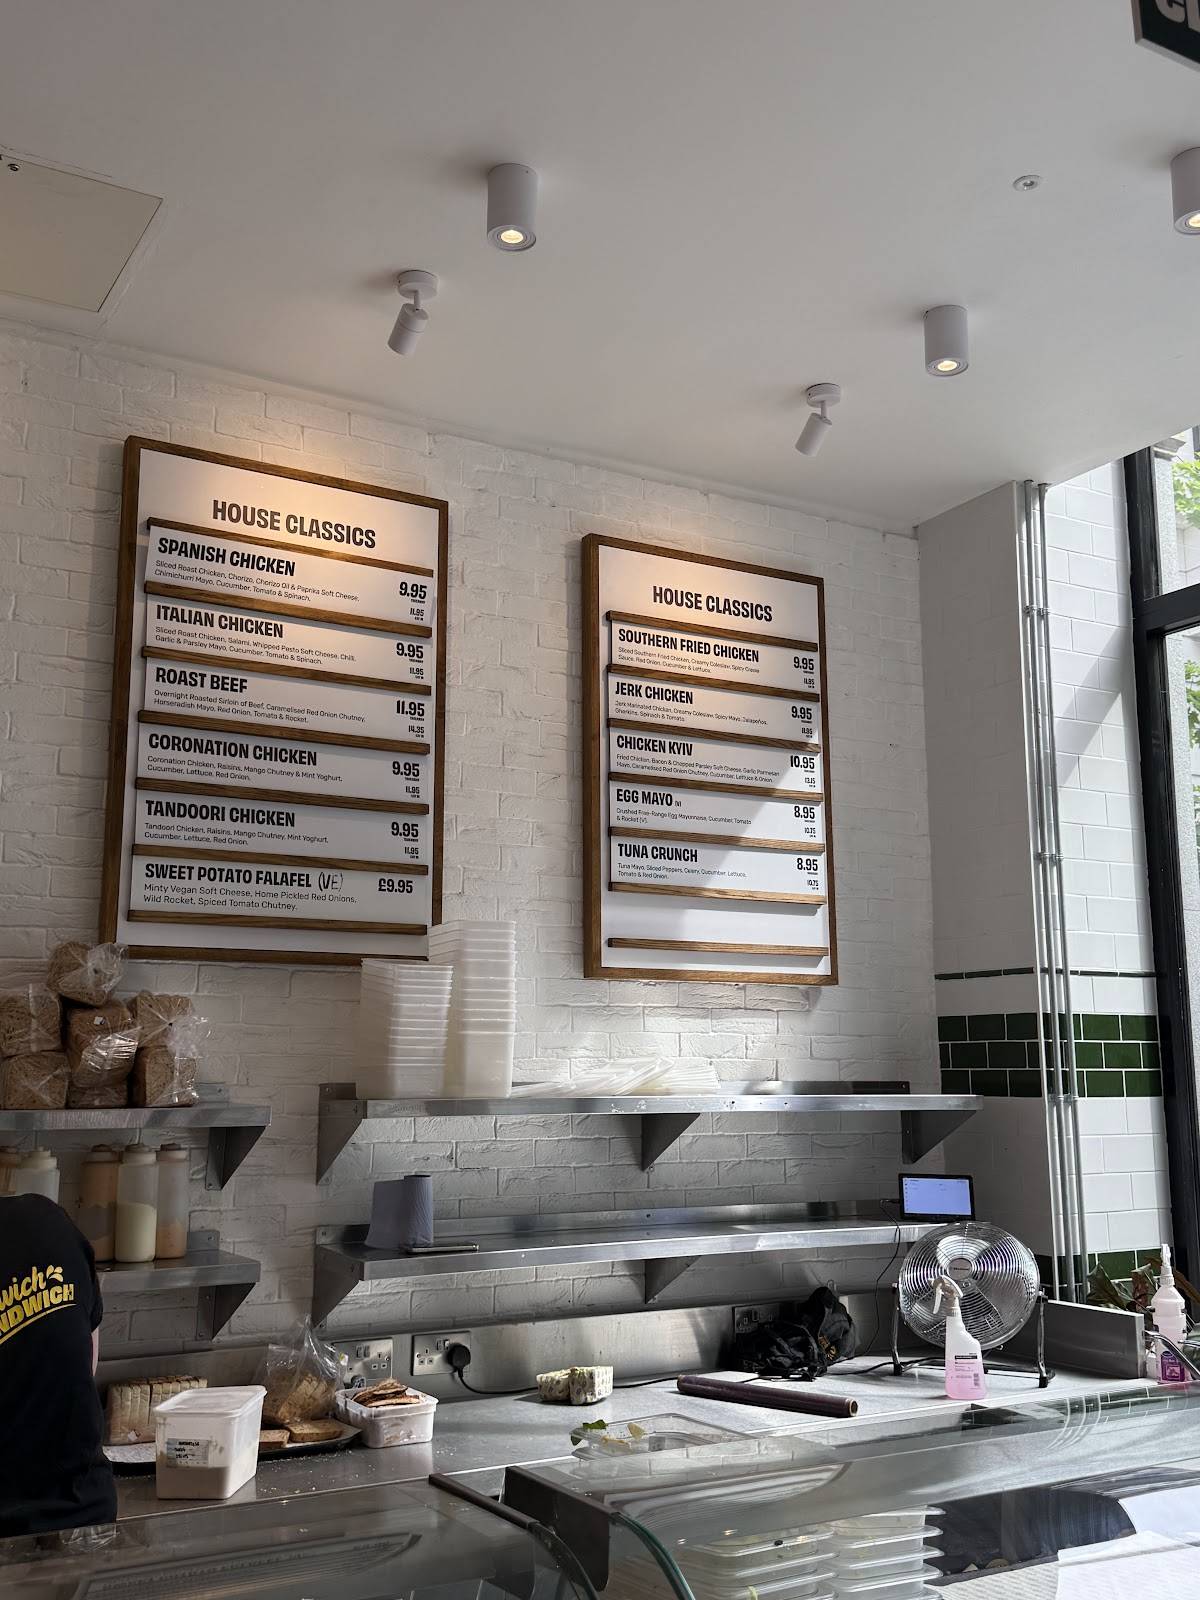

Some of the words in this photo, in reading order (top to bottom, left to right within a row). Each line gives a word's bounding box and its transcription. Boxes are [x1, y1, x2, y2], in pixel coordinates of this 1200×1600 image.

[212, 500, 280, 531] HOUSE
[286, 514, 376, 548] CLASSICS
[157, 537, 226, 564] SPANISH
[229, 550, 295, 576] CHICKEN
[155, 560, 176, 570] Sliced
[178, 564, 197, 573] Roast
[255, 577, 280, 587] Chorizo
[400, 582, 427, 599] 9.95
[410, 607, 424, 616] 11.95
[653, 586, 702, 610] HOUSE
[706, 596, 772, 622] CLASSICS
[156, 605, 214, 627] ITALIAN
[218, 614, 283, 637] CHICKEN
[155, 626, 176, 635] Sliced
[177, 629, 197, 638] Roast
[252, 641, 279, 650] Whipped
[618, 629, 677, 650] SOUTHERN
[680, 639, 710, 654] FRIED
[713, 644, 759, 662] CHICKEN
[396, 642, 424, 660] 9.95
[409, 667, 424, 676] 11.95
[793, 656, 814, 670] 9.95
[155, 667, 206, 688] ROAST
[210, 675, 247, 693] BEEF
[154, 689, 187, 700] Overnight
[189, 694, 216, 703] Roasted
[266, 704, 304, 714] Caramelised
[615, 682, 642, 697] JERK
[645, 686, 693, 704] CHICKEN
[397, 700, 425, 717] 11.95
[792, 706, 812, 720] 9.95
[148, 733, 248, 758] CORONATION
[252, 745, 316, 766] CHICKEN
[616, 735, 666, 754] CHICKEN
[669, 742, 693, 756] KYIV
[147, 755, 185, 765] Coronation
[243, 766, 266, 774] Mango
[267, 768, 293, 778] Chutney
[392, 761, 420, 777] 9.95
[790, 755, 815, 769] 10.95
[406, 786, 420, 795] 11.95
[616, 789, 638, 804] EGG
[642, 791, 673, 806] MAYO
[145, 800, 225, 821] TANDOORI
[229, 807, 295, 827] CHICKEN
[794, 806, 815, 819] 8.95
[391, 822, 418, 838] 9.95
[404, 846, 419, 855] 11.95
[618, 844, 648, 859] TUNA
[651, 846, 698, 862] CRUNCH
[796, 858, 818, 871] 8.95
[144, 863, 194, 880] SWEET
[197, 866, 251, 883] POTATO
[255, 870, 311, 887] FALAFEL
[318, 872, 343, 891] (VE)
[144, 883, 168, 893] Minty
[170, 885, 196, 894] Vegan
[378, 878, 413, 894] £9.95
[198, 898, 226, 906] Spiced
